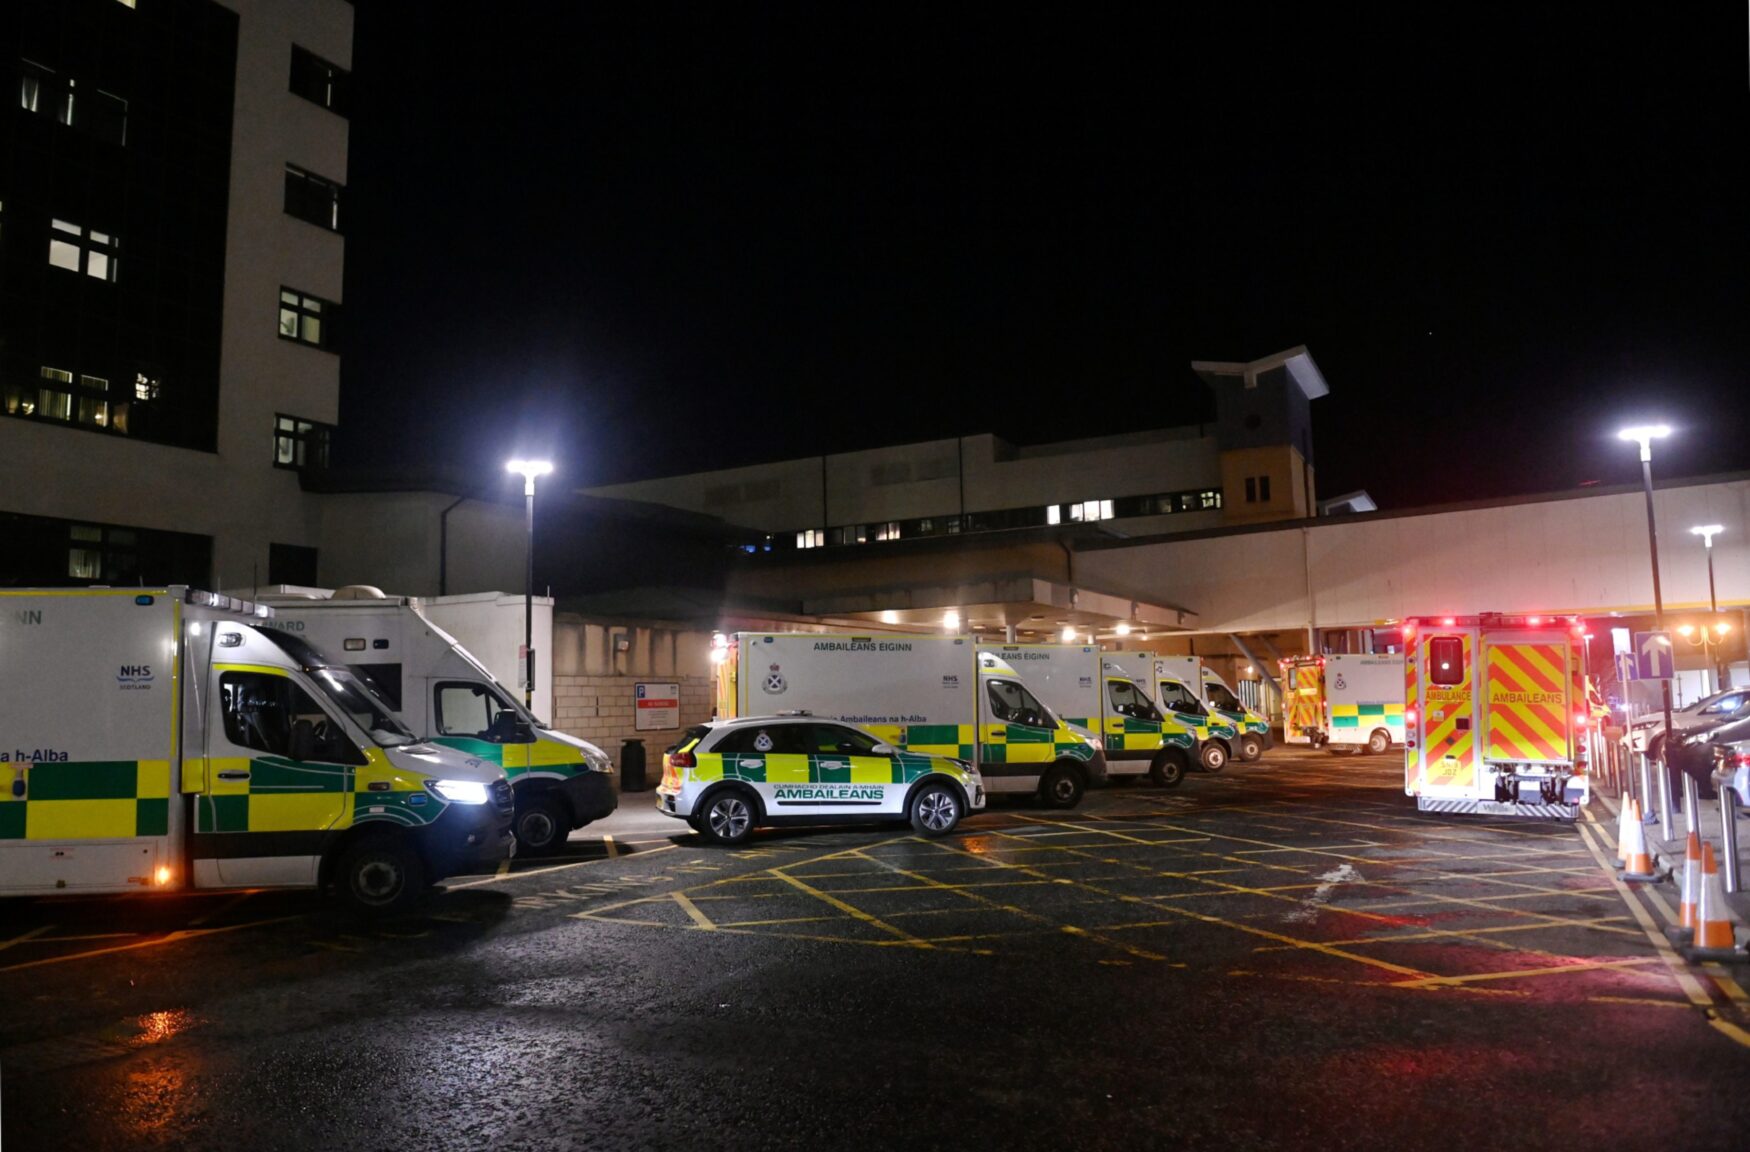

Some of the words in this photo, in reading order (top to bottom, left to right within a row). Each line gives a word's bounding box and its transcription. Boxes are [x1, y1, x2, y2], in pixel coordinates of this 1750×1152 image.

[813, 642, 877, 652] AMBAILEANS
[120, 665, 151, 676] NHS
[1426, 691, 1471, 701] AMBULANCE
[1493, 693, 1562, 704] AMBAILEANS
[840, 715, 887, 723] Ambaileans
[901, 714, 928, 723] h-Alba
[15, 749, 69, 763] h-Alba
[774, 789, 884, 800] AMBAILEANS
